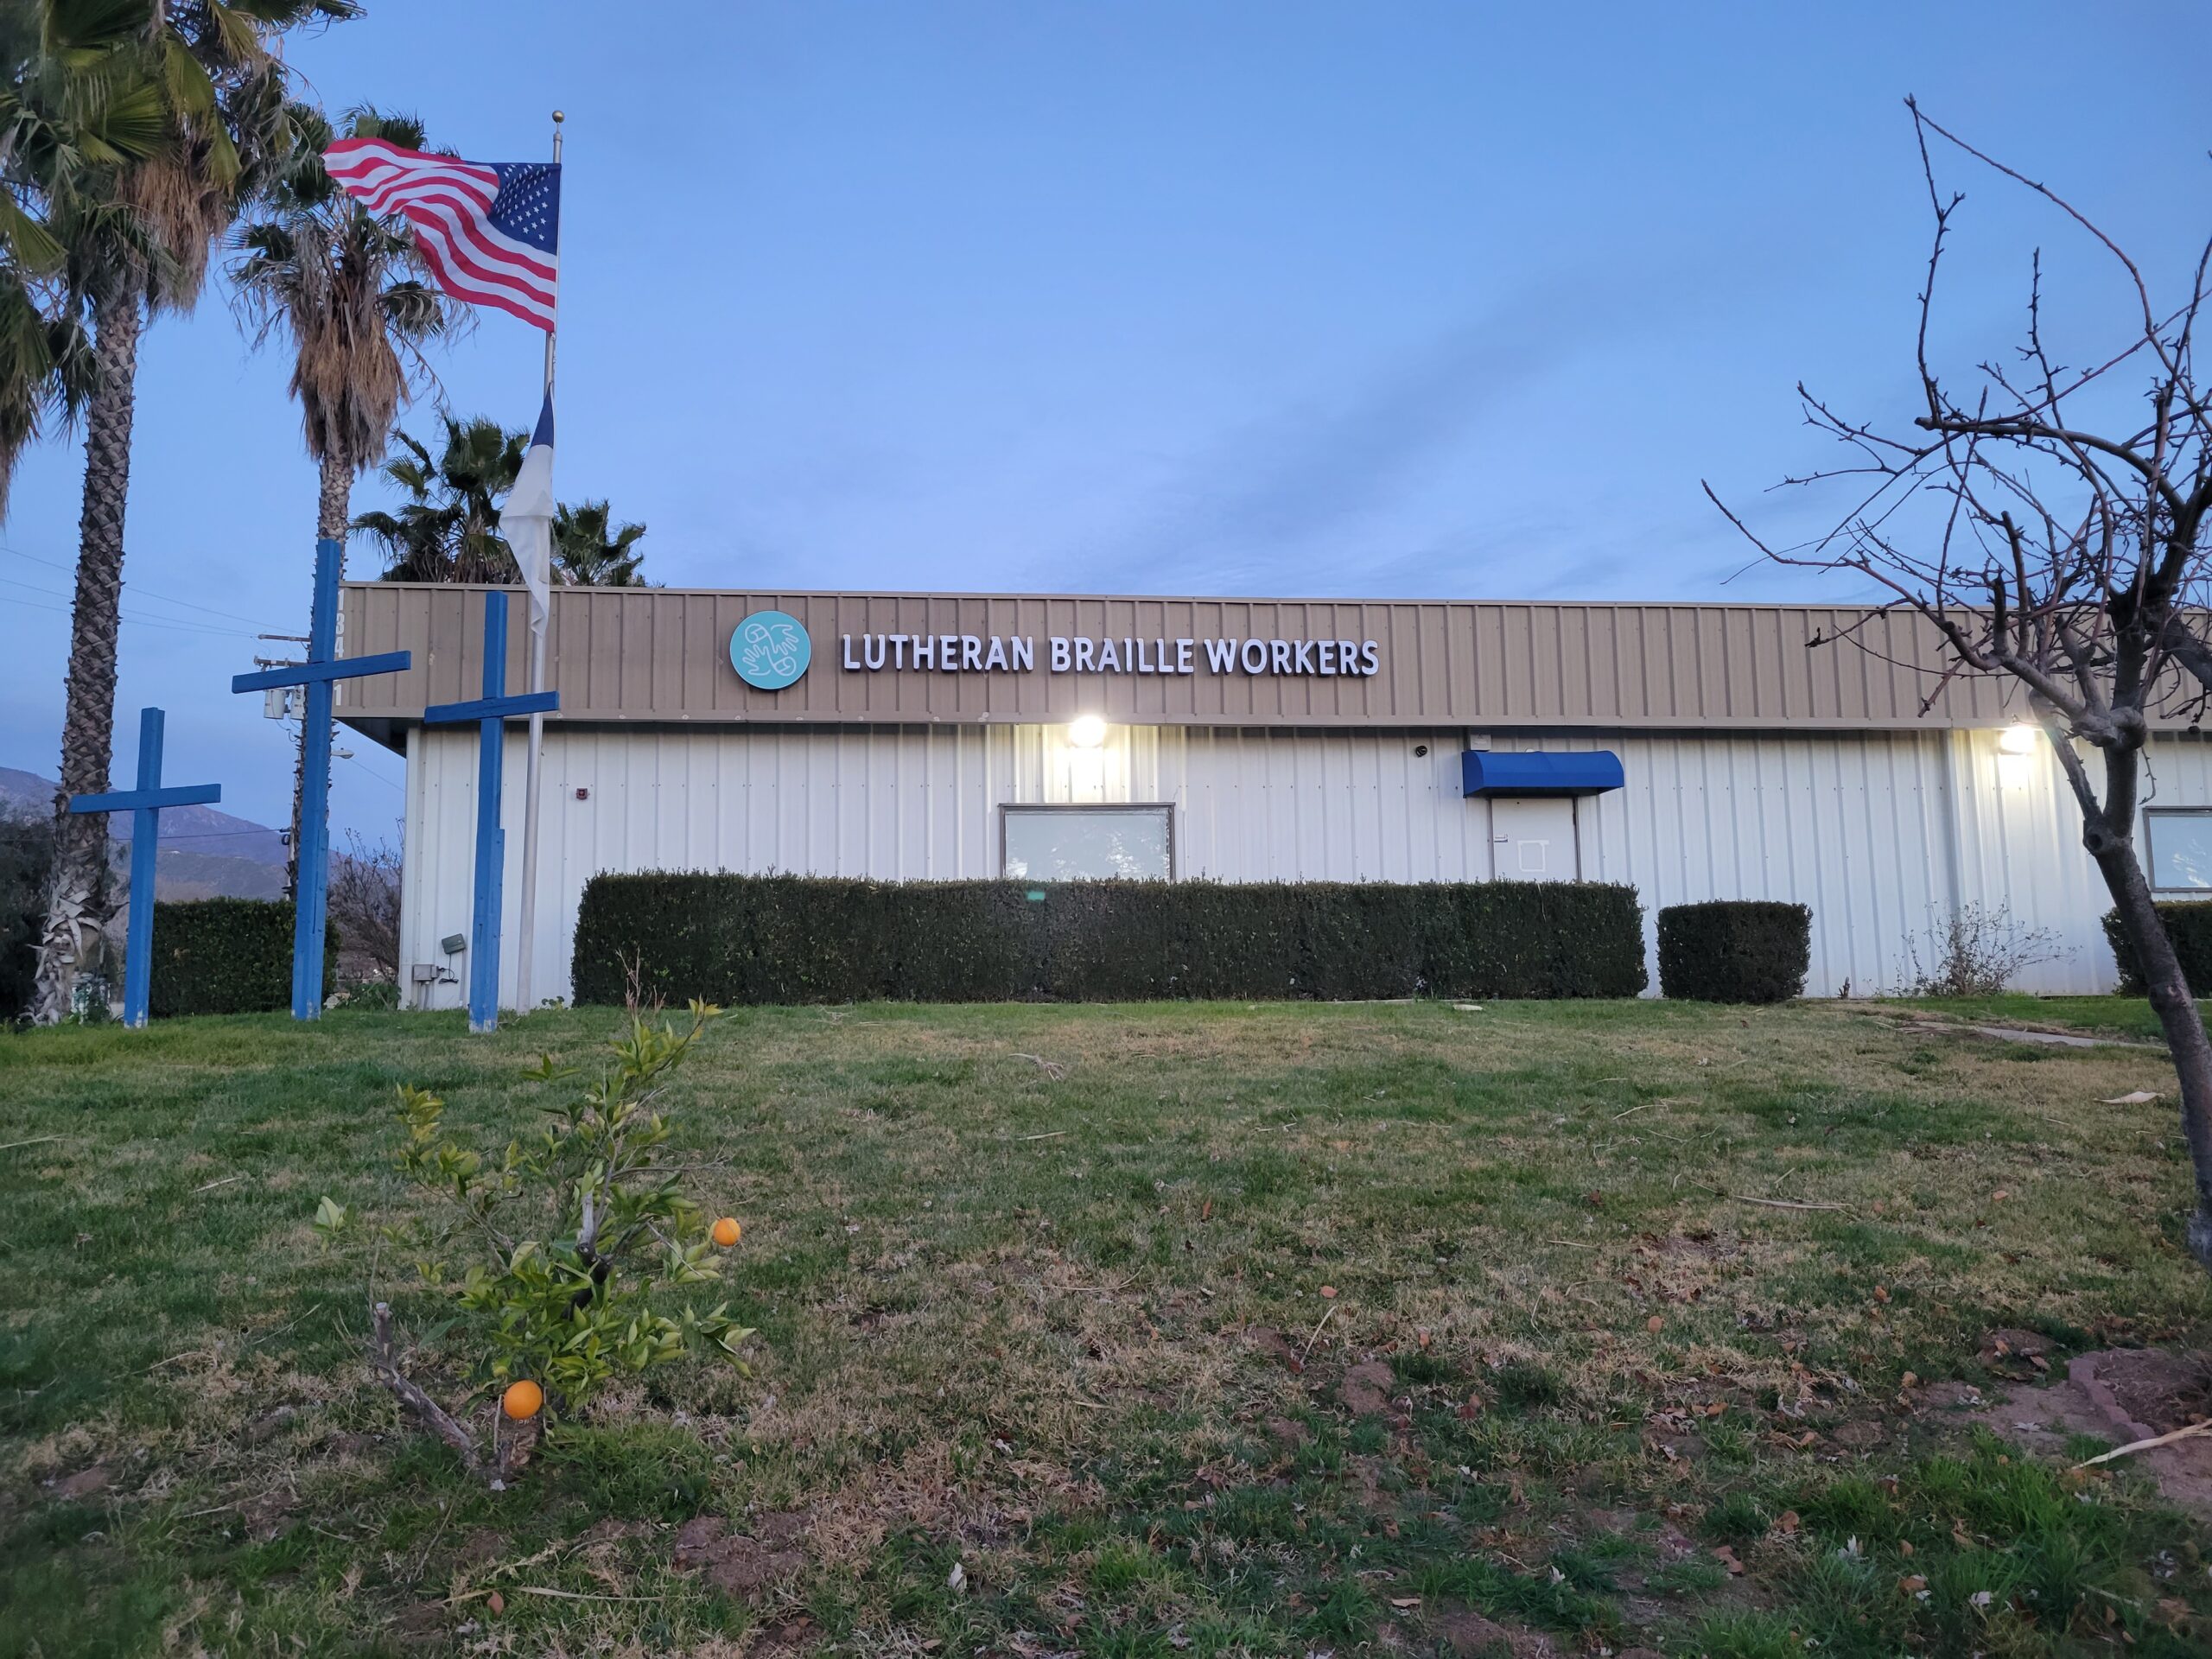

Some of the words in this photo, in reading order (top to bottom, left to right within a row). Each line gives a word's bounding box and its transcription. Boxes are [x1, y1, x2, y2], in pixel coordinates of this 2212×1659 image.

[334, 588, 345, 706] 1341
[842, 633, 1033, 671] LUTHERAN
[1050, 636, 1194, 674] BRAILLE
[1204, 638, 1379, 677] WORKERS
